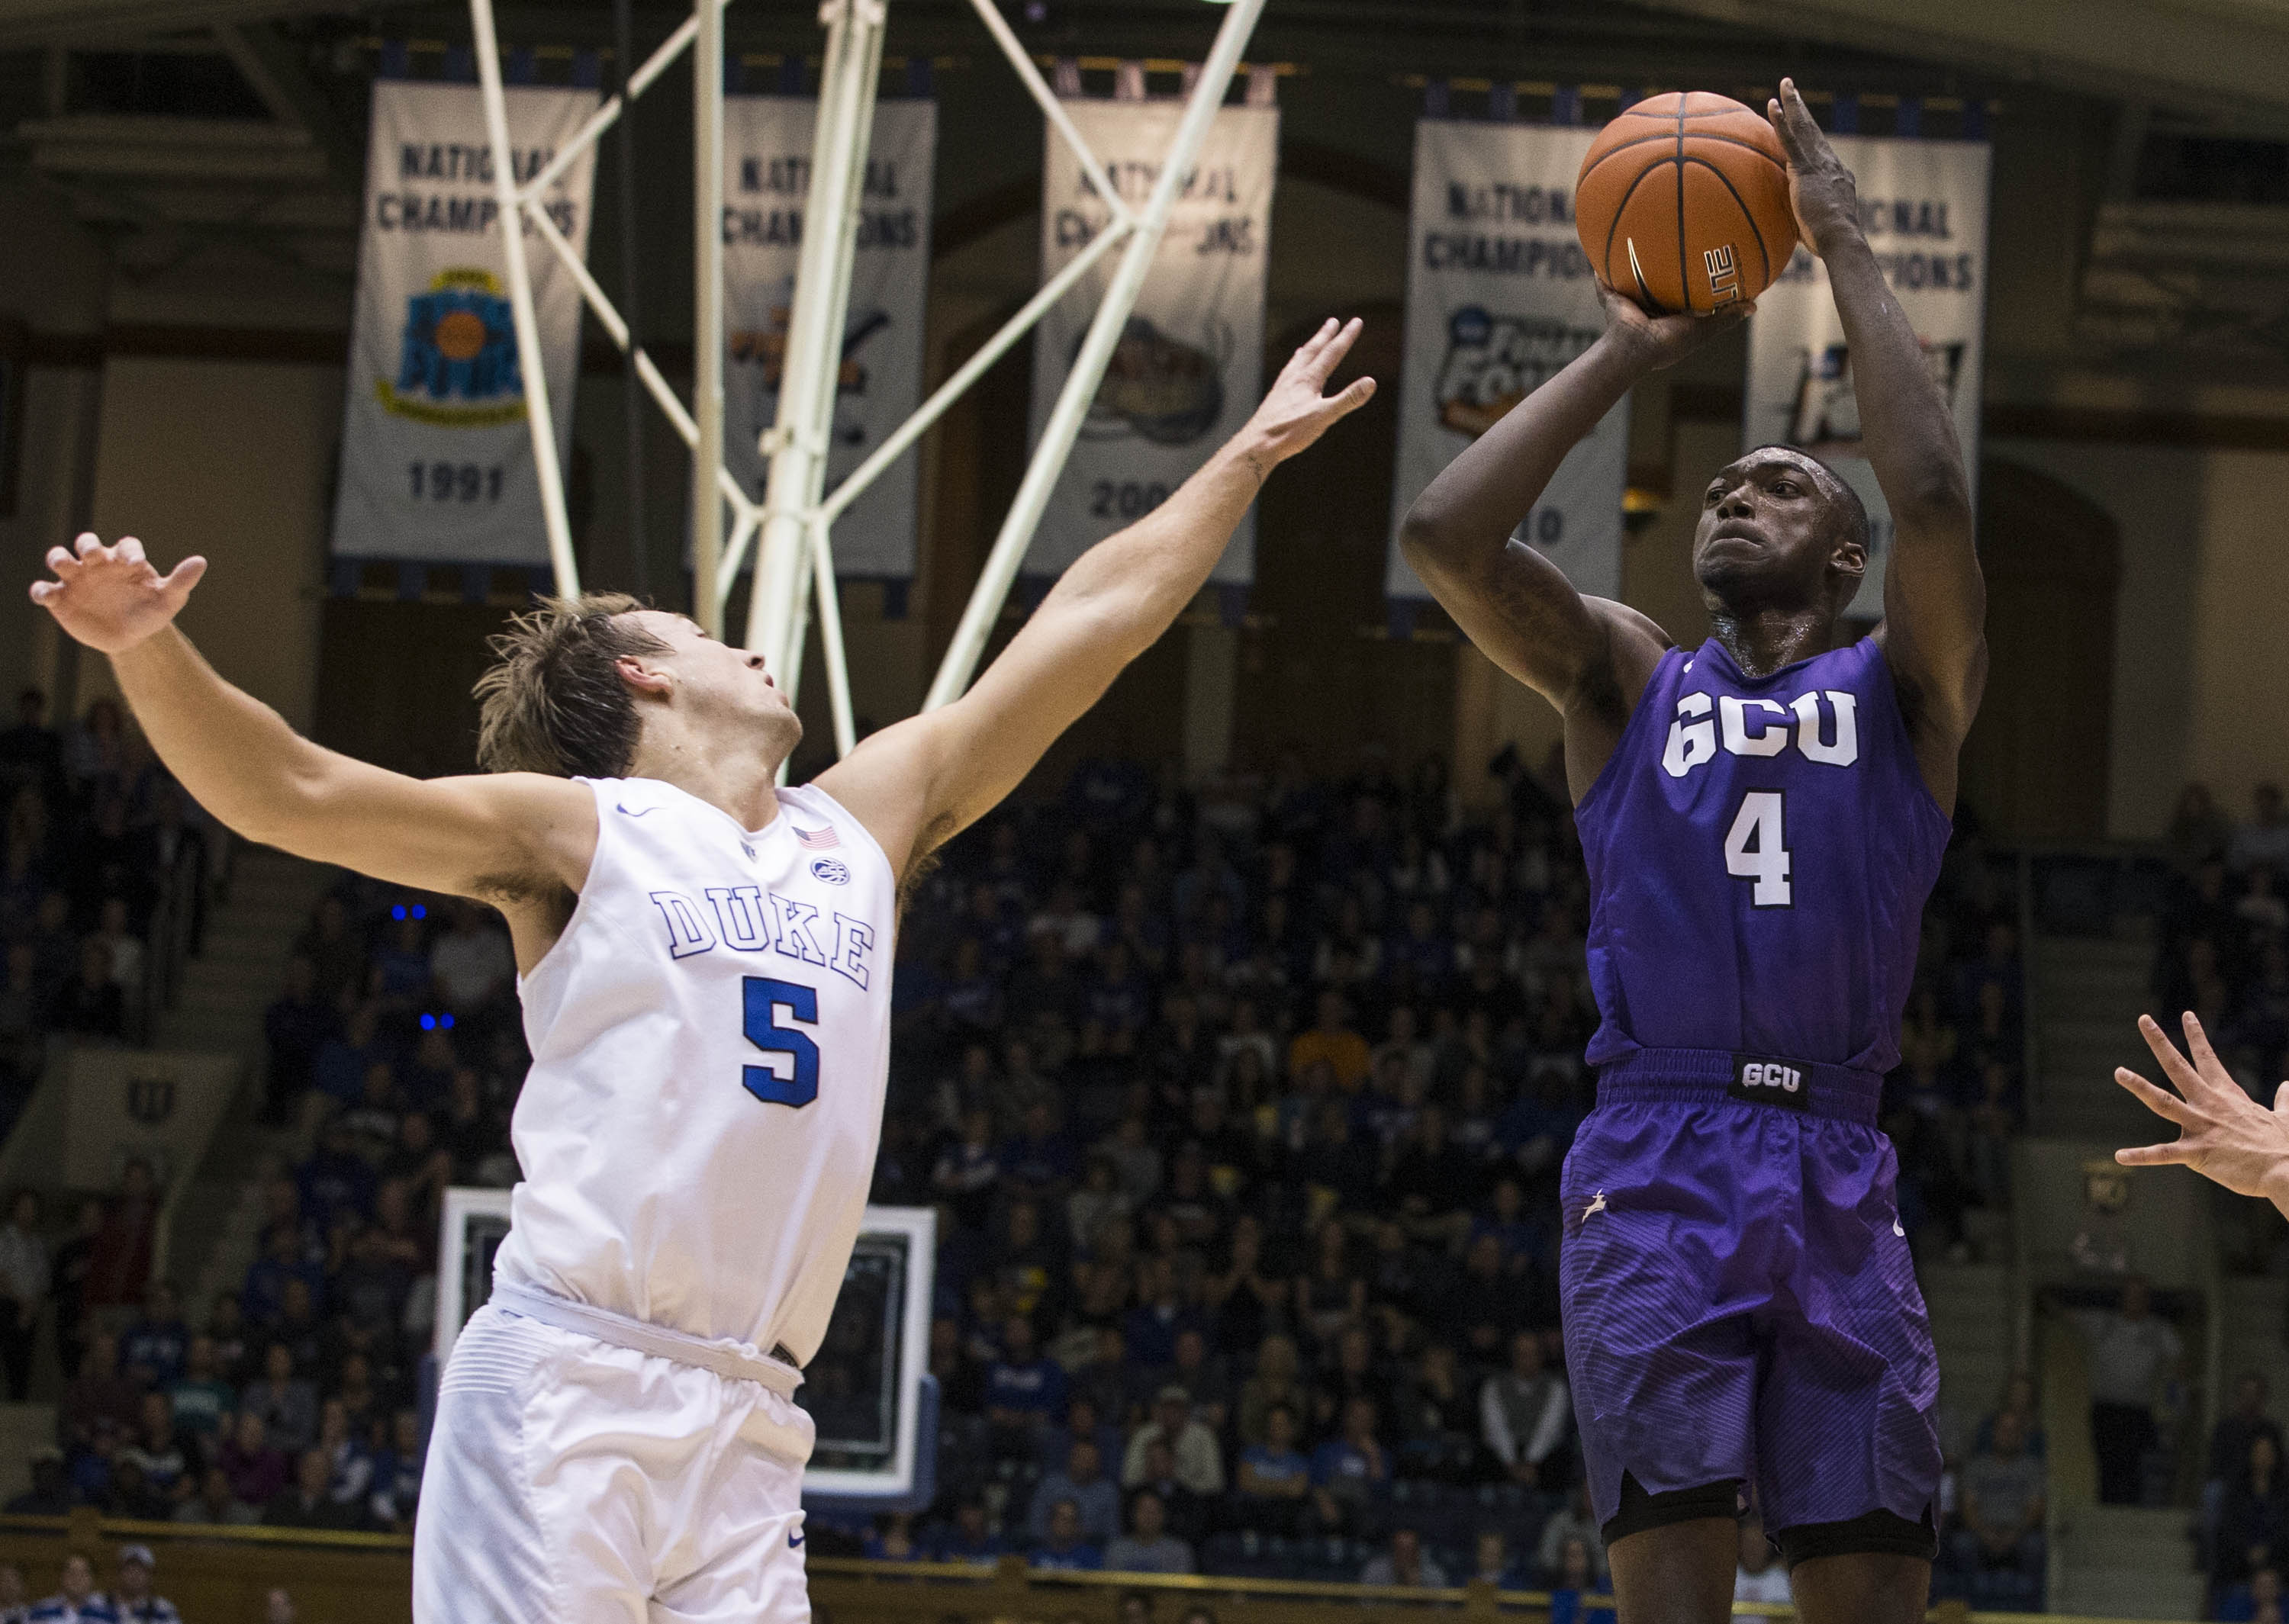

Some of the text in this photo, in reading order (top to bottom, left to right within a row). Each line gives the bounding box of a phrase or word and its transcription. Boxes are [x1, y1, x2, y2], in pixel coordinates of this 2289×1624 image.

[398, 142, 563, 189] NATIOA
[1447, 182, 1578, 226] NATION
[1424, 233, 1595, 281] CHAMPIO
[409, 461, 504, 503] 1991
[1090, 478, 1175, 520] 200
[1661, 690, 1859, 778] GCU
[1724, 790, 1792, 907] 4
[649, 885, 876, 992] DUKE
[742, 975, 820, 1109] 5
[1742, 1063, 1801, 1093] GCU
